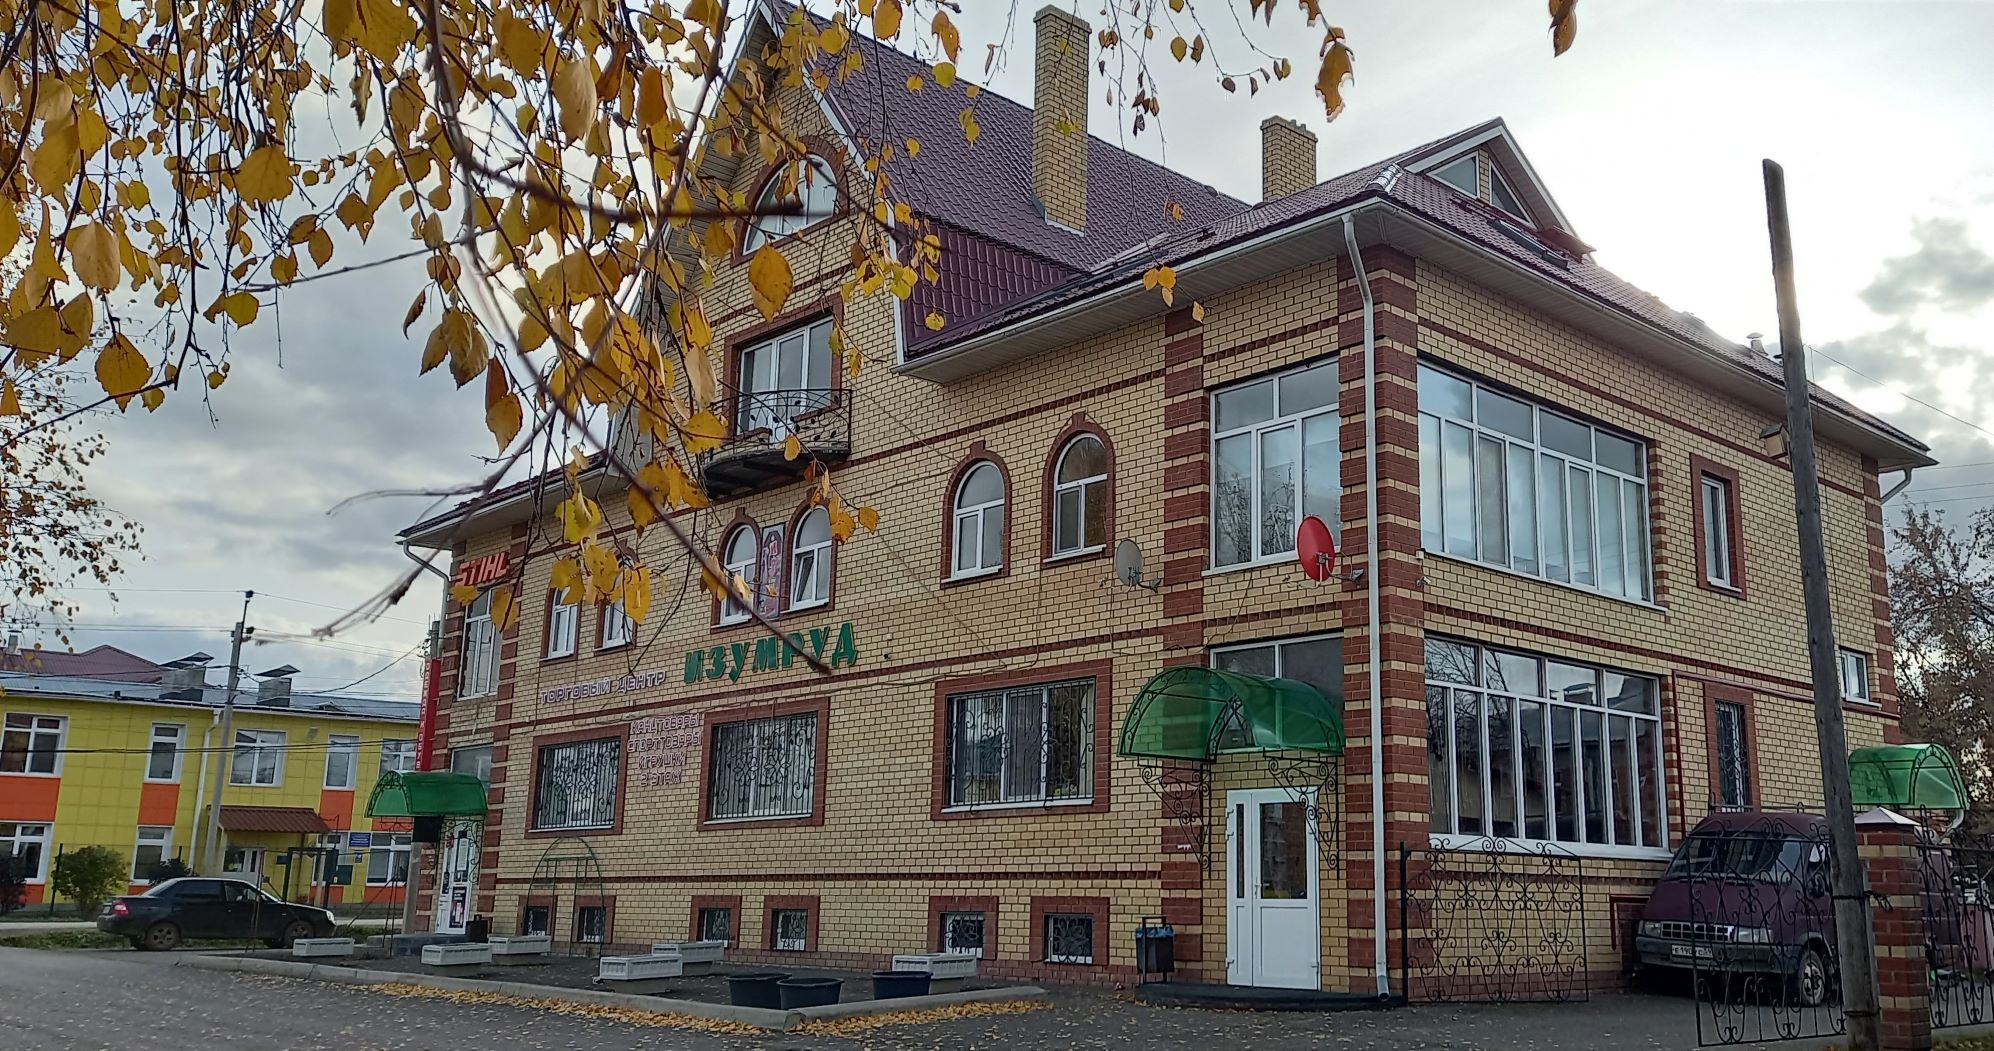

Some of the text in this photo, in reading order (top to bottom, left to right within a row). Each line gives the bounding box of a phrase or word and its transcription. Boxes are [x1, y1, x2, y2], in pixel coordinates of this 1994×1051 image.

[456, 552, 508, 586] STIHL
[684, 622, 858, 684] ИЗУМРУД
[421, 662, 431, 715] ОДЕЖДА
[539, 669, 666, 704] ТОРГОВЫЙ ЦЕНТР
[629, 713, 700, 735] КАНЦТОВАРЫ
[626, 730, 702, 753] СПОРТТОВАРЫ
[638, 752, 686, 770] ИГРУШКИ
[639, 768, 682, 787] 2 ЭТАЖ
